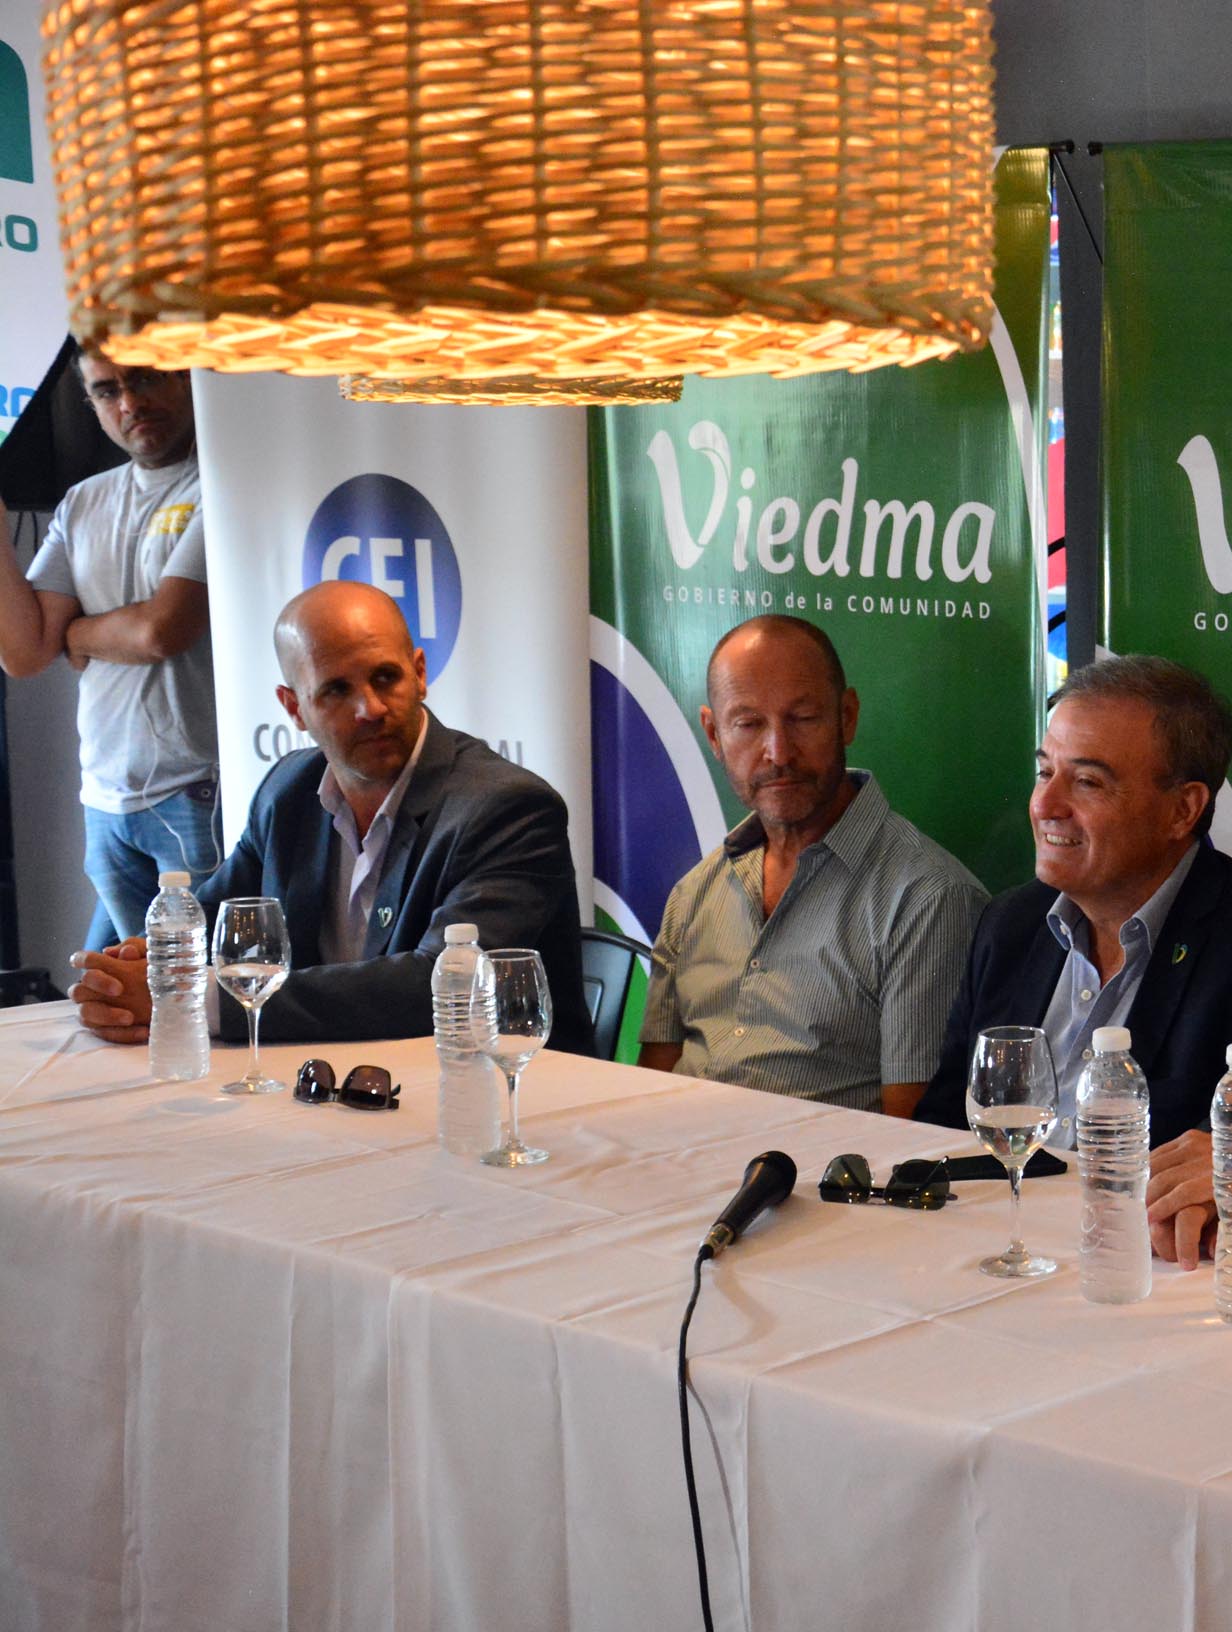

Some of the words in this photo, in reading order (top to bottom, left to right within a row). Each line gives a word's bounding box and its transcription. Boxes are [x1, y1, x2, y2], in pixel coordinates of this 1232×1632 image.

[646, 420, 997, 584] Viedma
[662, 585, 773, 608] GOBIERNO
[784, 591, 806, 609] de
[816, 593, 833, 611] la
[847, 595, 991, 619] COMUNIDAD
